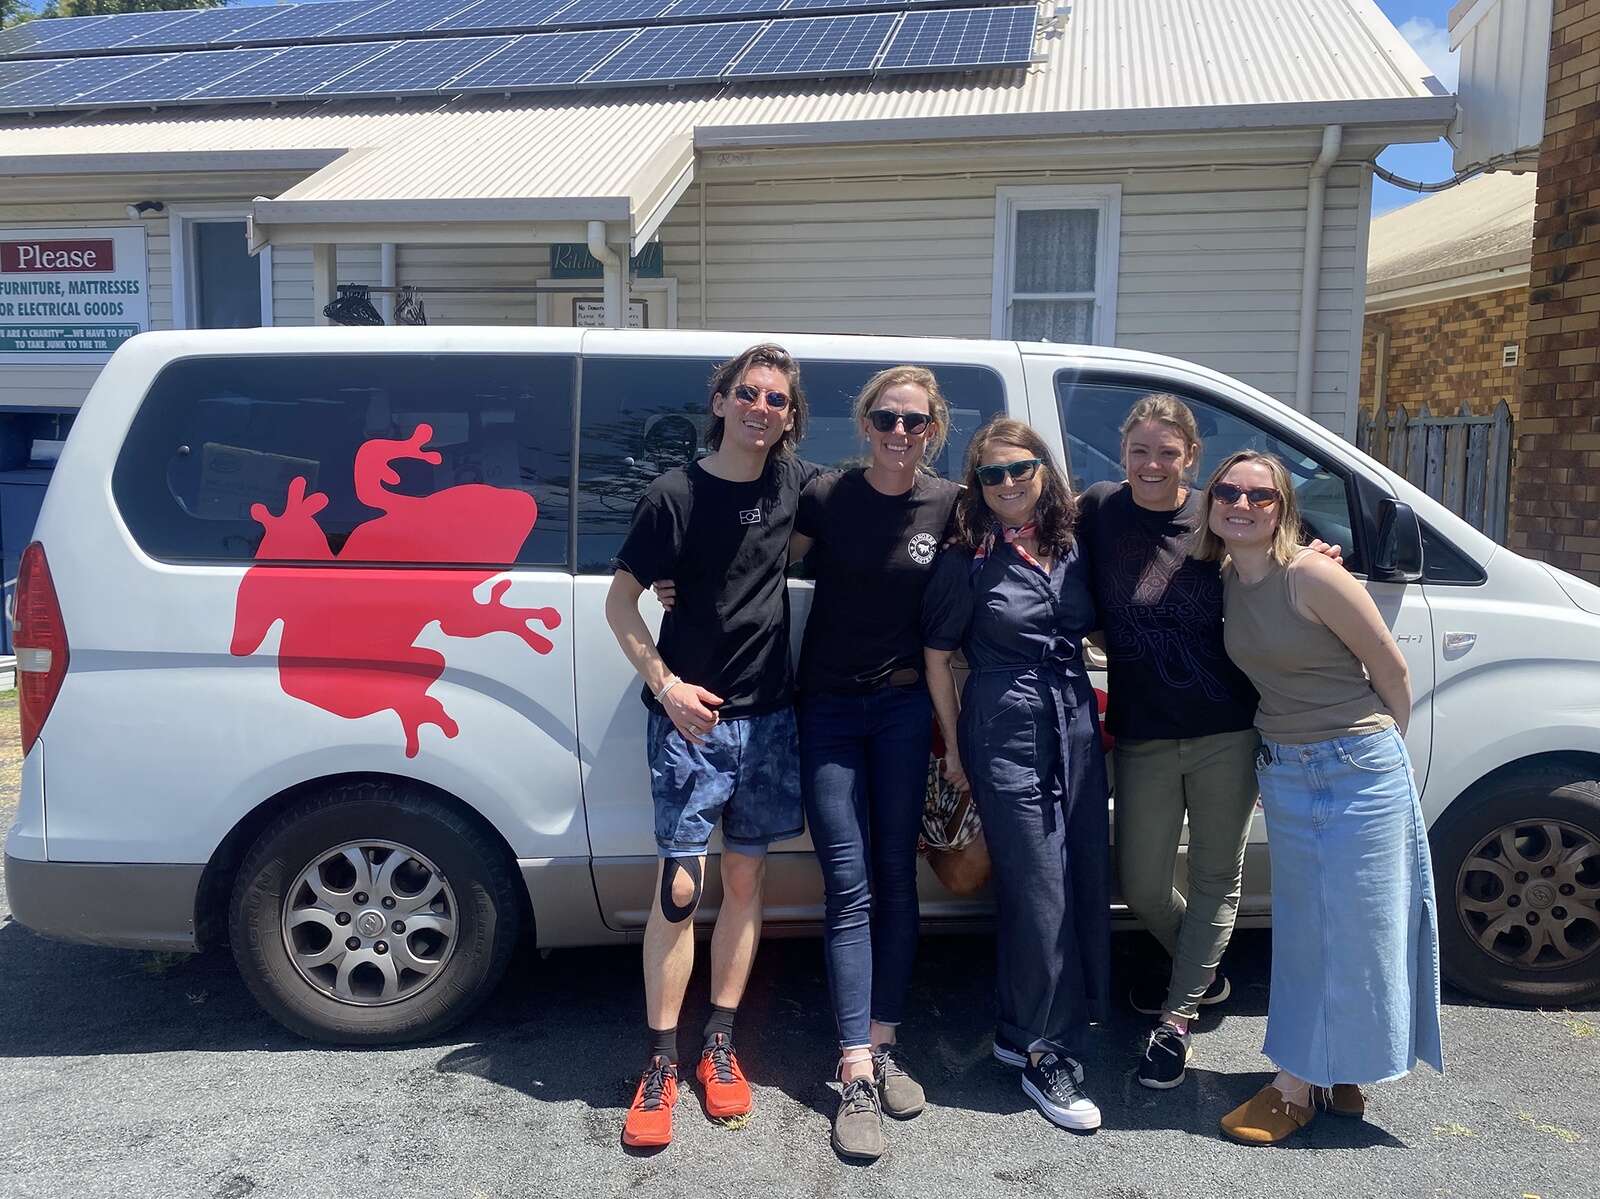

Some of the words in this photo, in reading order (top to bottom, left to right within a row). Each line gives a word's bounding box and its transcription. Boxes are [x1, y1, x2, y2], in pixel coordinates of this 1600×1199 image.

[17, 245, 97, 268] Please
[0, 281, 65, 297] FURNITURE,
[68, 280, 140, 295] MATTRESSES
[0, 302, 14, 316] OR
[17, 302, 81, 316] ELECTRICAL
[84, 302, 124, 316] GOODS
[86, 329, 105, 338] HAVE
[106, 329, 117, 338] TO
[118, 329, 134, 338] PAY
[15, 340, 25, 349] TO
[27, 340, 45, 349] TAKE
[67, 340, 77, 349] TO
[78, 340, 93, 349] THE
